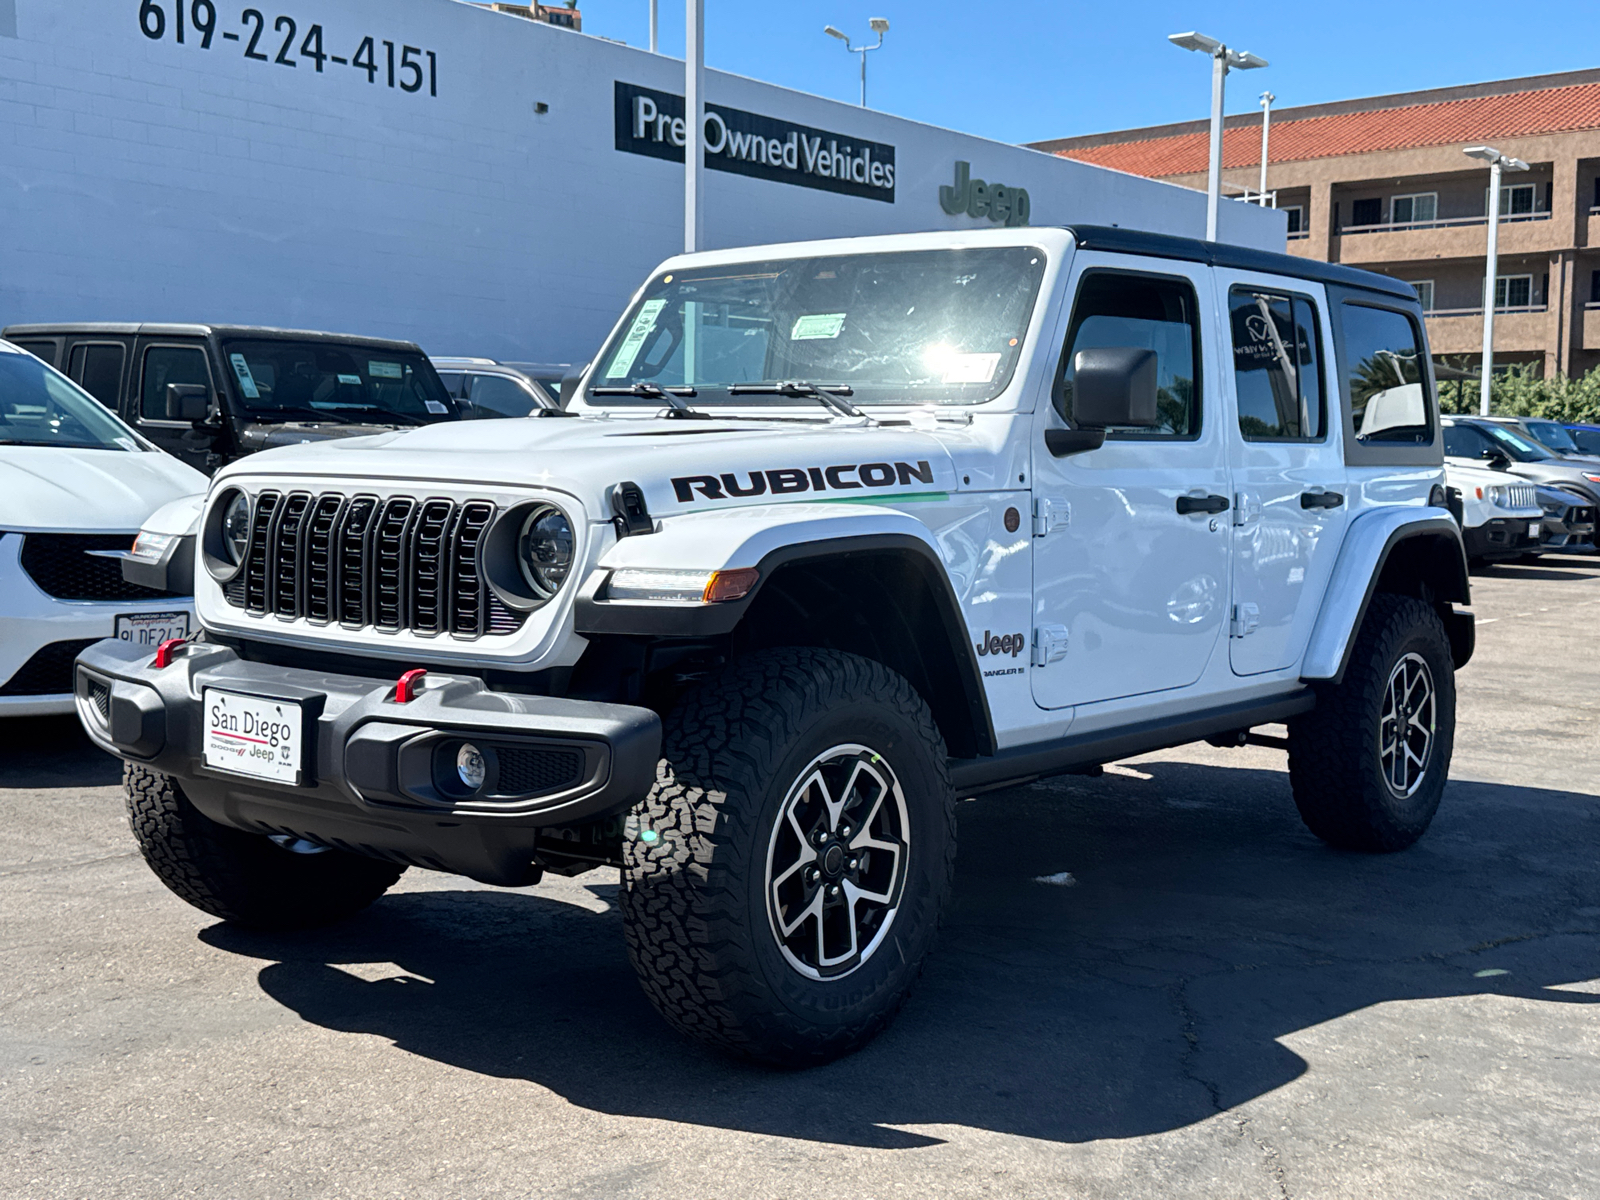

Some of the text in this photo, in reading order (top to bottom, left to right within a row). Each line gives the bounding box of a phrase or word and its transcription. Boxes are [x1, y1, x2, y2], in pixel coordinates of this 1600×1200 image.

[138, 0, 438, 98] 619-224-4151
[801, 132, 894, 189] Vehicles
[939, 160, 1030, 227] Jeep
[670, 460, 935, 503] RUBICON
[976, 630, 1025, 658] Jeep
[211, 705, 291, 748] San Diego
[249, 744, 275, 763] Jeep
